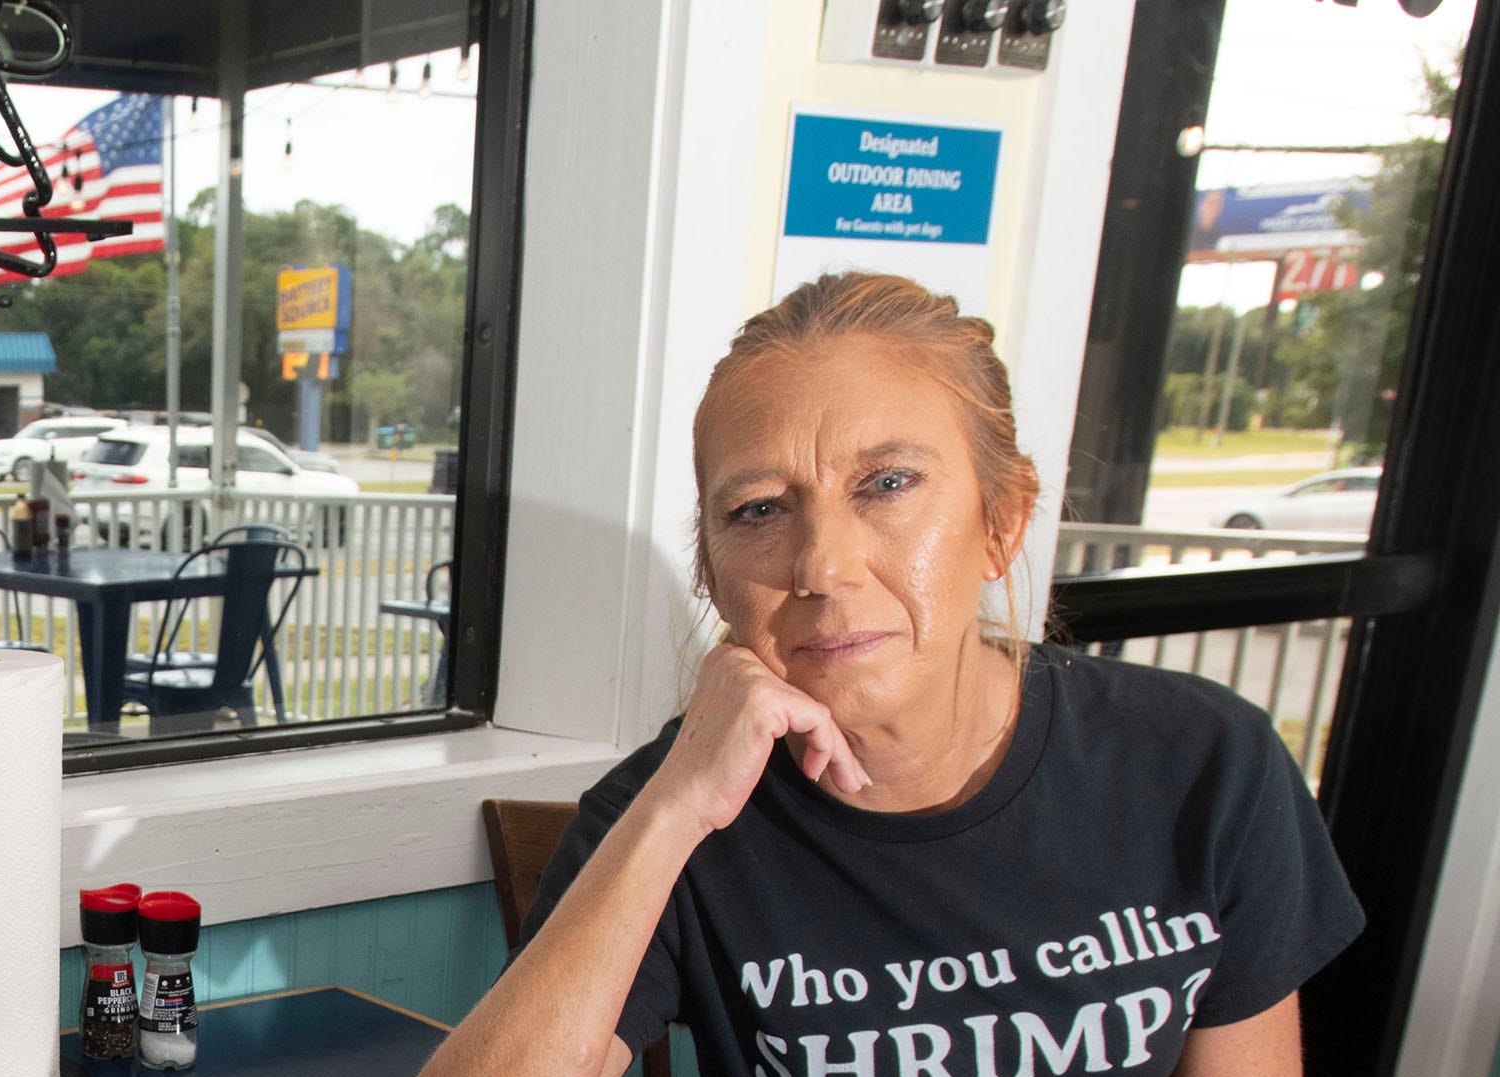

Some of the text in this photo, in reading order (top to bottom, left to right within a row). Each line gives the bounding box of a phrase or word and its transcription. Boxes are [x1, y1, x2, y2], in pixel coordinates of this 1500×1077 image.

[859, 130, 939, 159] Designated
[828, 162, 961, 191] OUTDOOR DINING
[870, 192, 913, 214] AREA
[741, 905, 1222, 1010] Who you callin
